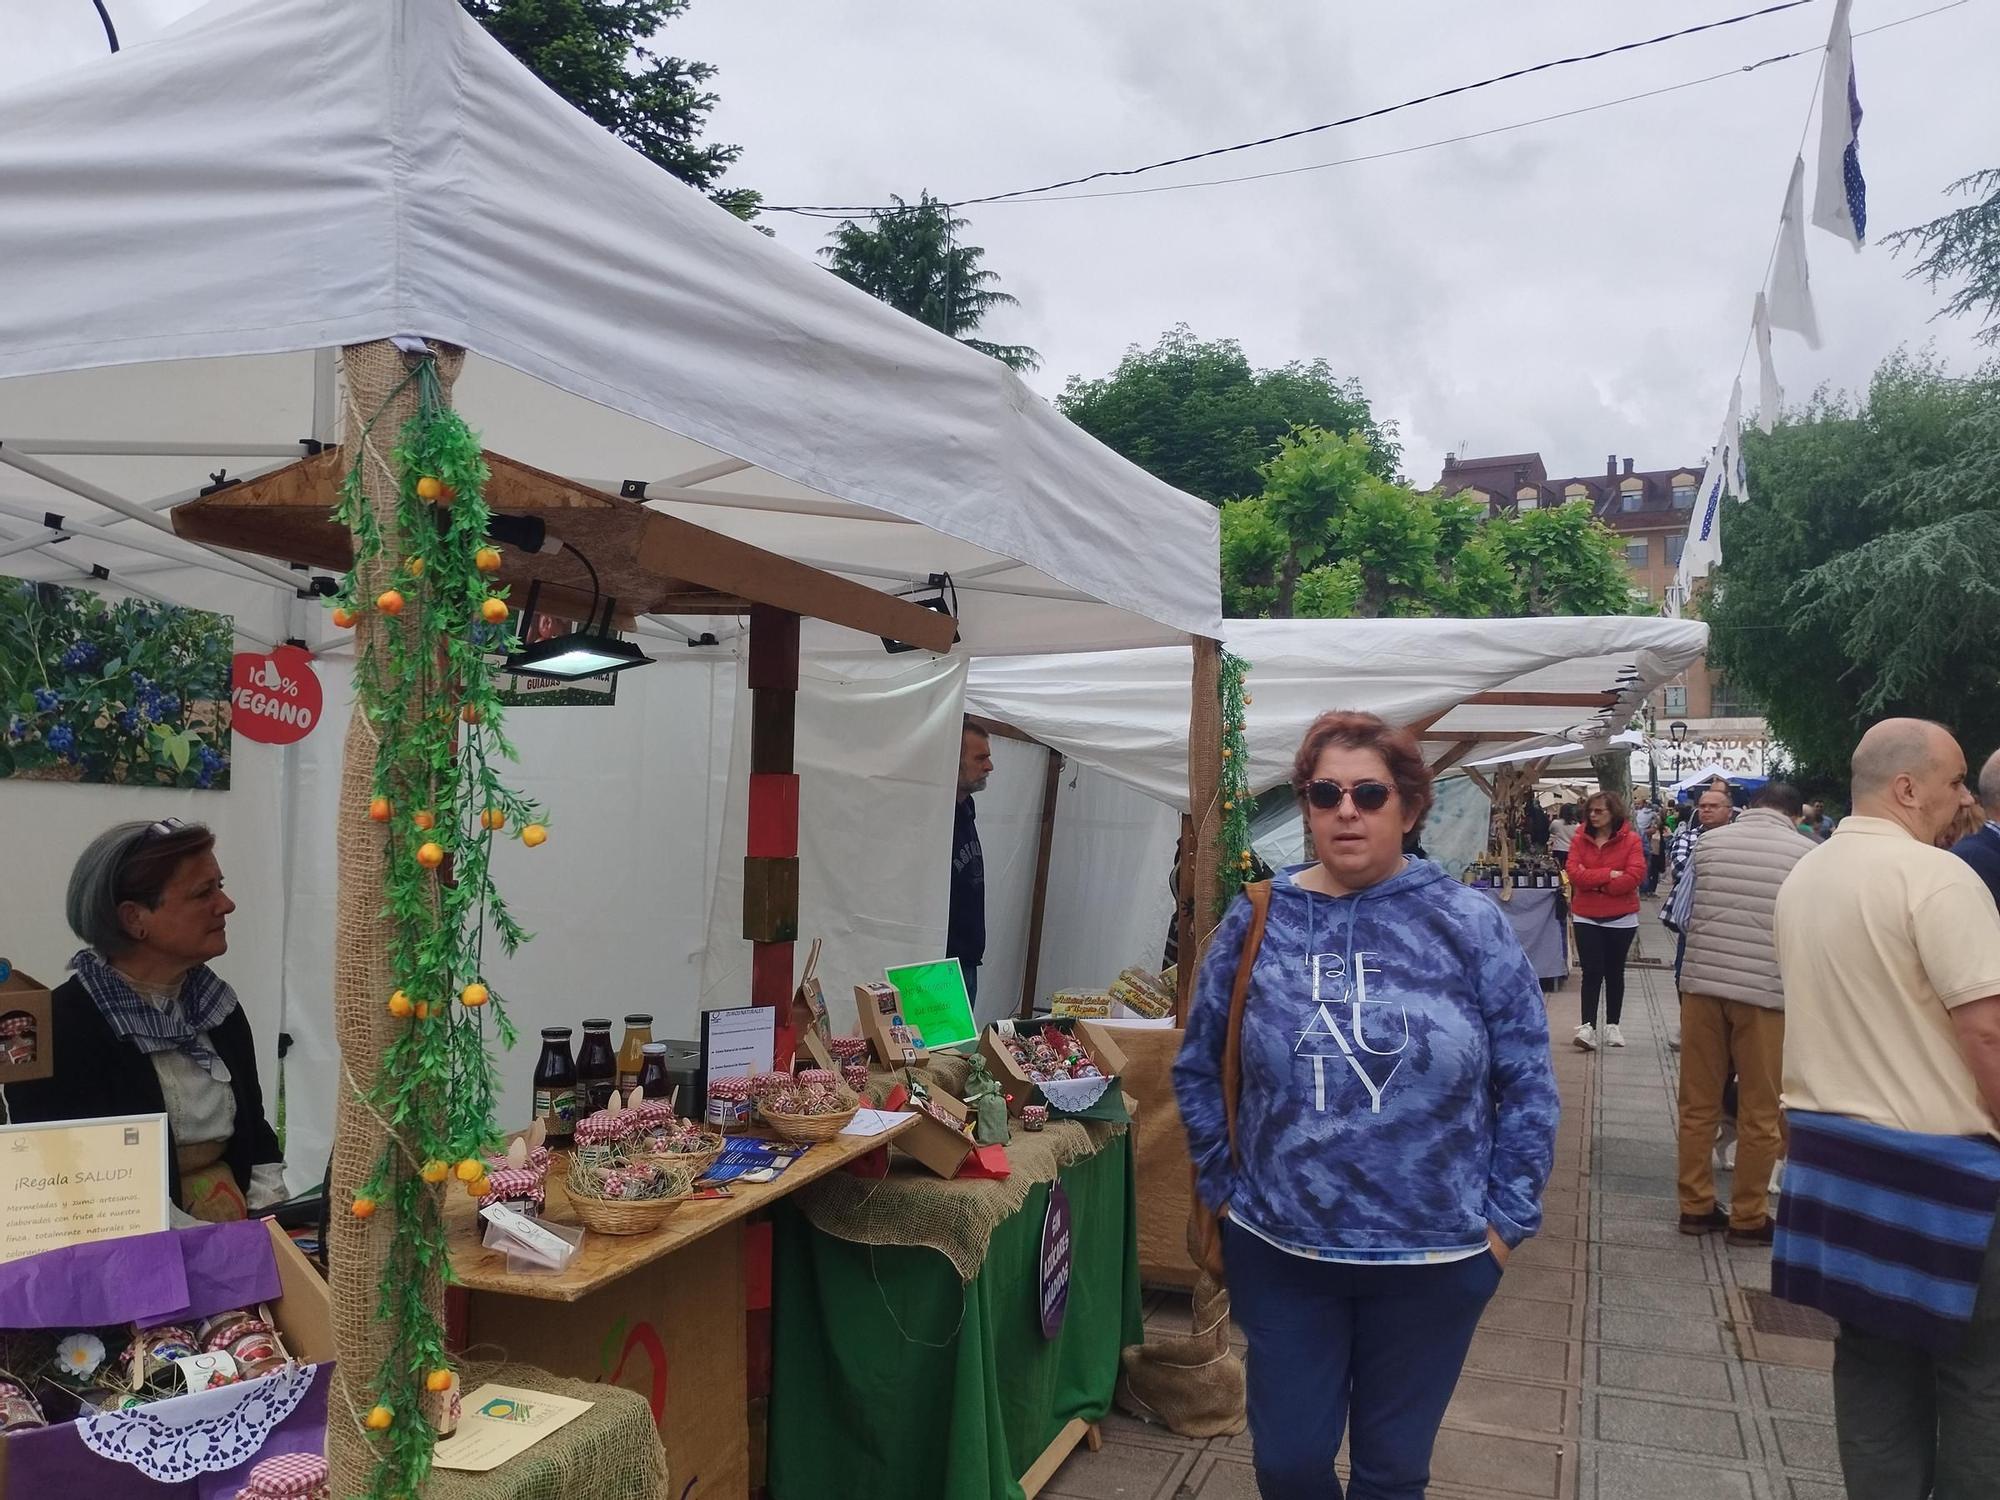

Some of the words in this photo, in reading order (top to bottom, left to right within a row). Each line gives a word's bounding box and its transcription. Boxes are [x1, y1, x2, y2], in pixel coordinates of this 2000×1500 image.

[249, 666, 298, 697] 10%
[527, 678, 560, 690] GUIADAS
[1703, 737, 1769, 751] ISIDRO
[15, 1173, 69, 1191] ¡Regala
[75, 1168, 133, 1184] SALUD!
[7, 1202, 58, 1212] Mermeladas
[6, 1217, 51, 1228] elaborados
[72, 1213, 94, 1221] fruta
[97, 1210, 107, 1219] de
[110, 1208, 141, 1218] nuestra
[35, 1229, 81, 1240] totalmente
[86, 1224, 124, 1235] naturales
[129, 1223, 141, 1231] sin
